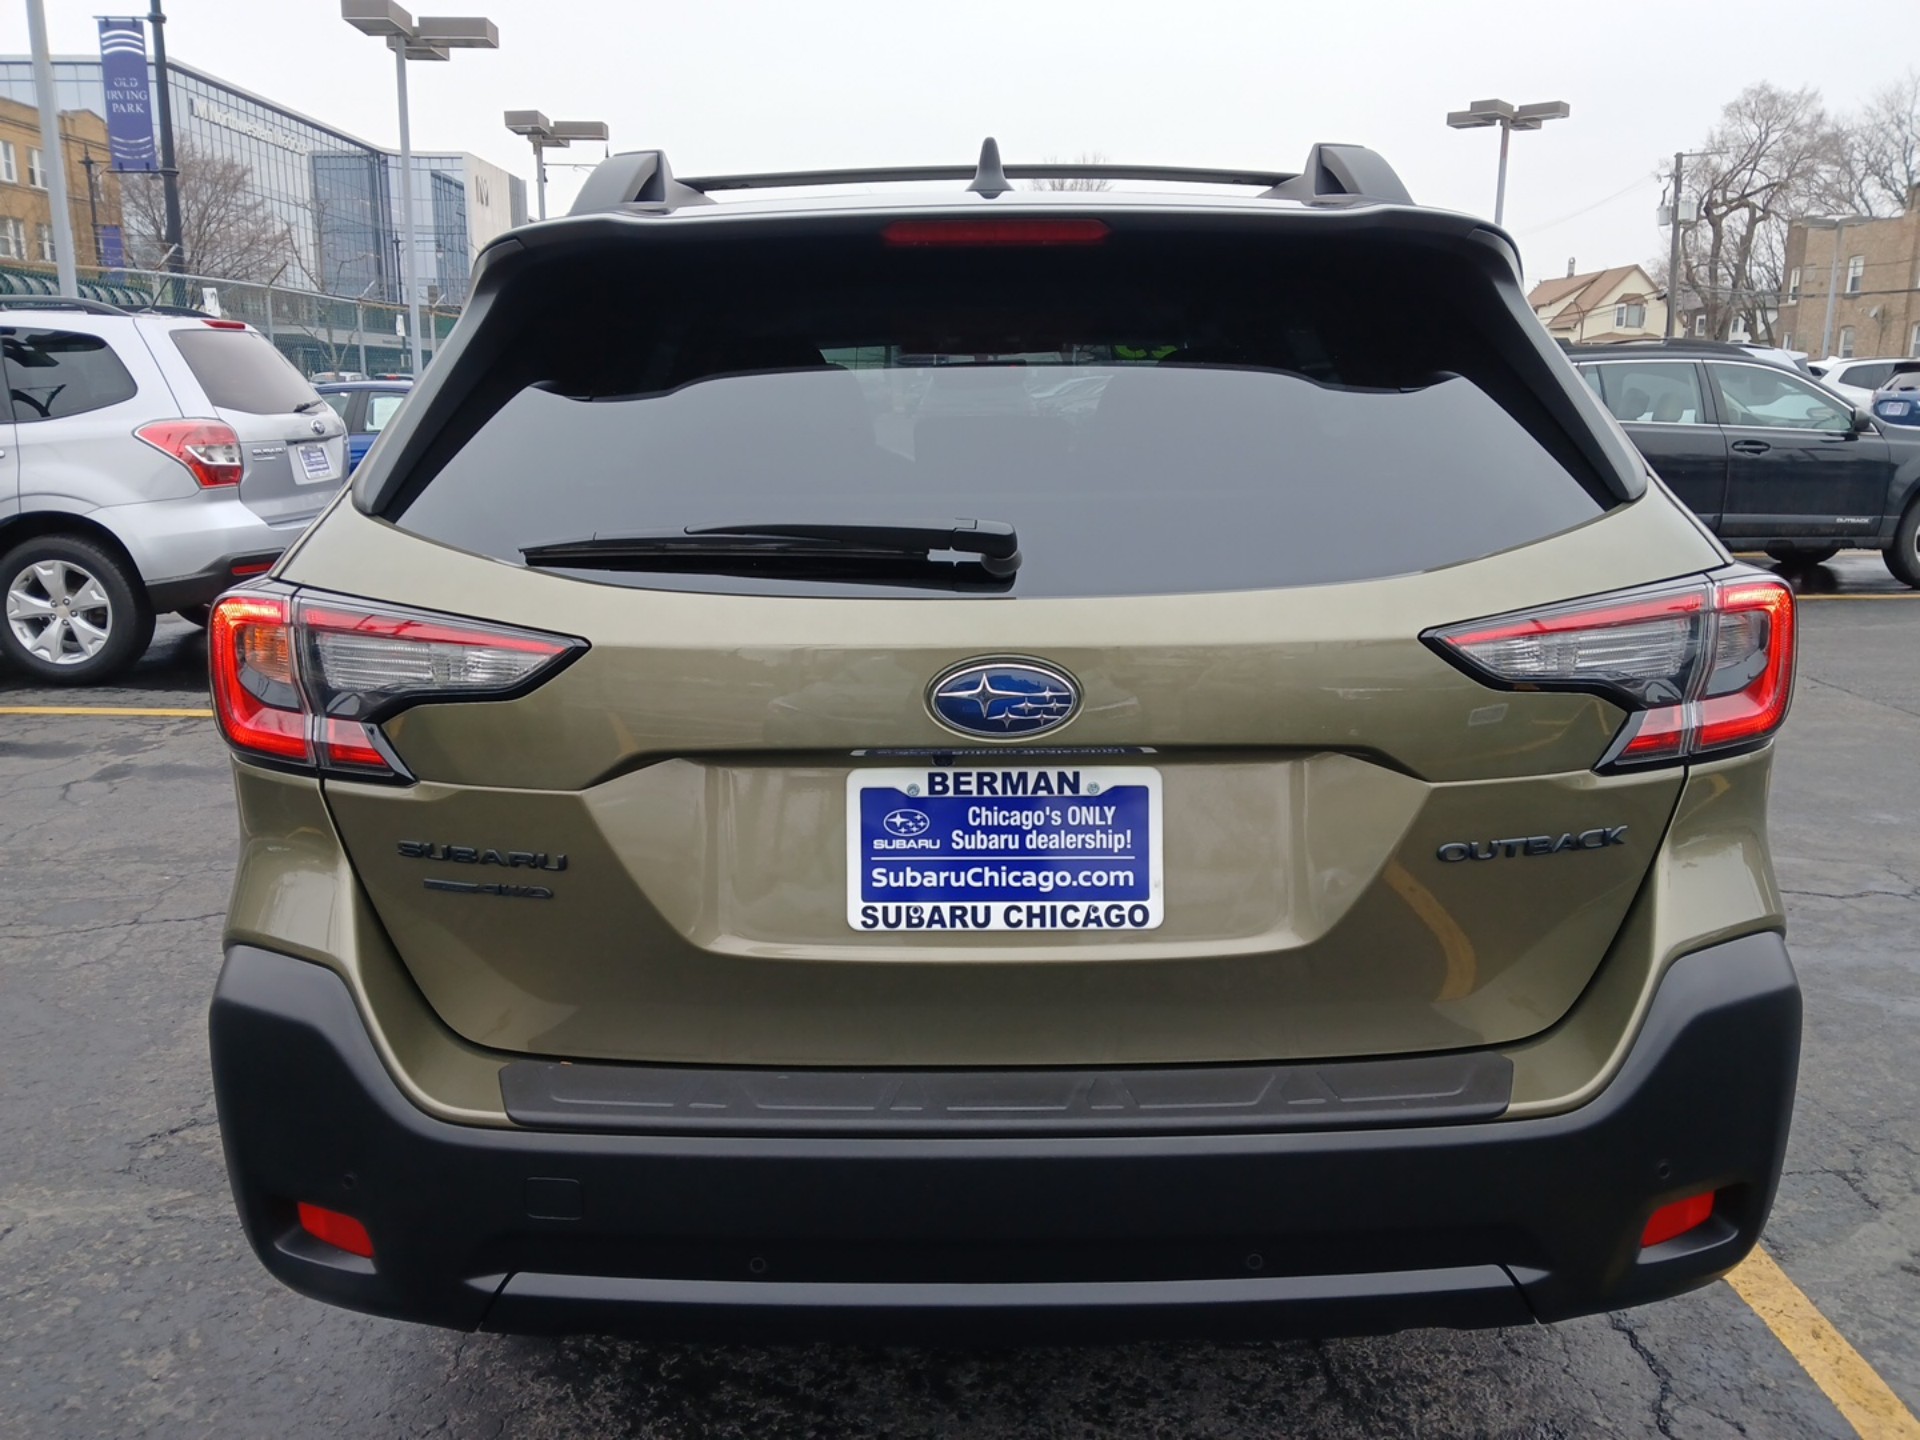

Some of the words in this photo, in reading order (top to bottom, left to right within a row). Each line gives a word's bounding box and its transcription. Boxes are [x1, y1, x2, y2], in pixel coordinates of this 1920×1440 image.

[113, 77, 138, 88] OLD
[106, 90, 148, 101] IRVING
[111, 103, 145, 113] PARK
[927, 771, 1081, 796] BERMAN
[967, 806, 1062, 830] Chicago's
[1067, 806, 1116, 826] ONLY
[873, 839, 941, 849] SUBARU
[951, 830, 1020, 850] Subaru
[1025, 829, 1132, 852] dealership!
[1435, 824, 1629, 863] OUTBACK
[397, 840, 568, 871] SUBARU
[871, 866, 1135, 892] SubaruChicago.com
[860, 904, 992, 929] SUBARU
[1003, 904, 1150, 929] CHICAGO
